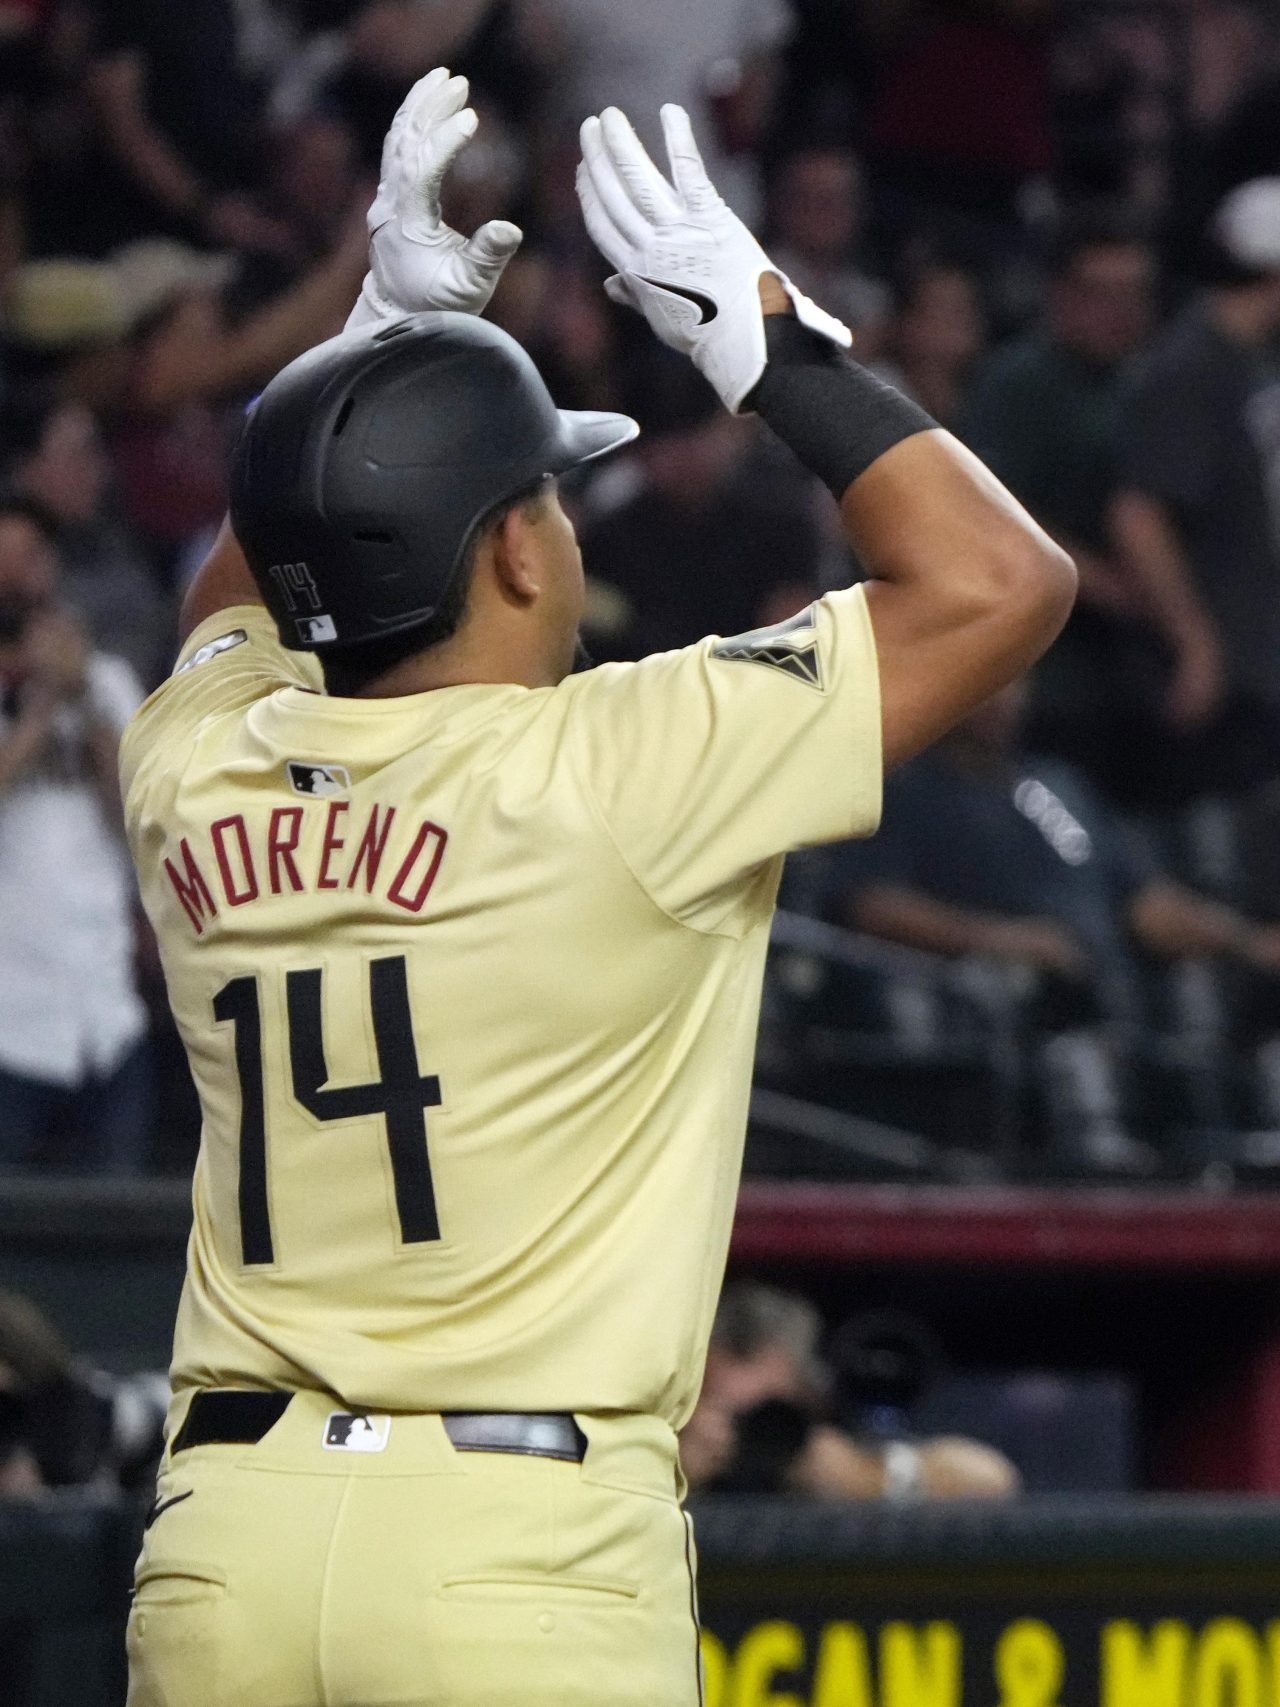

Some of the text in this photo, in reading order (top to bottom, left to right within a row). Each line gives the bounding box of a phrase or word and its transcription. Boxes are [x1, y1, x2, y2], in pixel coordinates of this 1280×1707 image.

[268, 562, 322, 611] 14
[164, 801, 448, 936] MORENO
[212, 955, 442, 1265] 14
[699, 1619, 963, 1707] GAN
